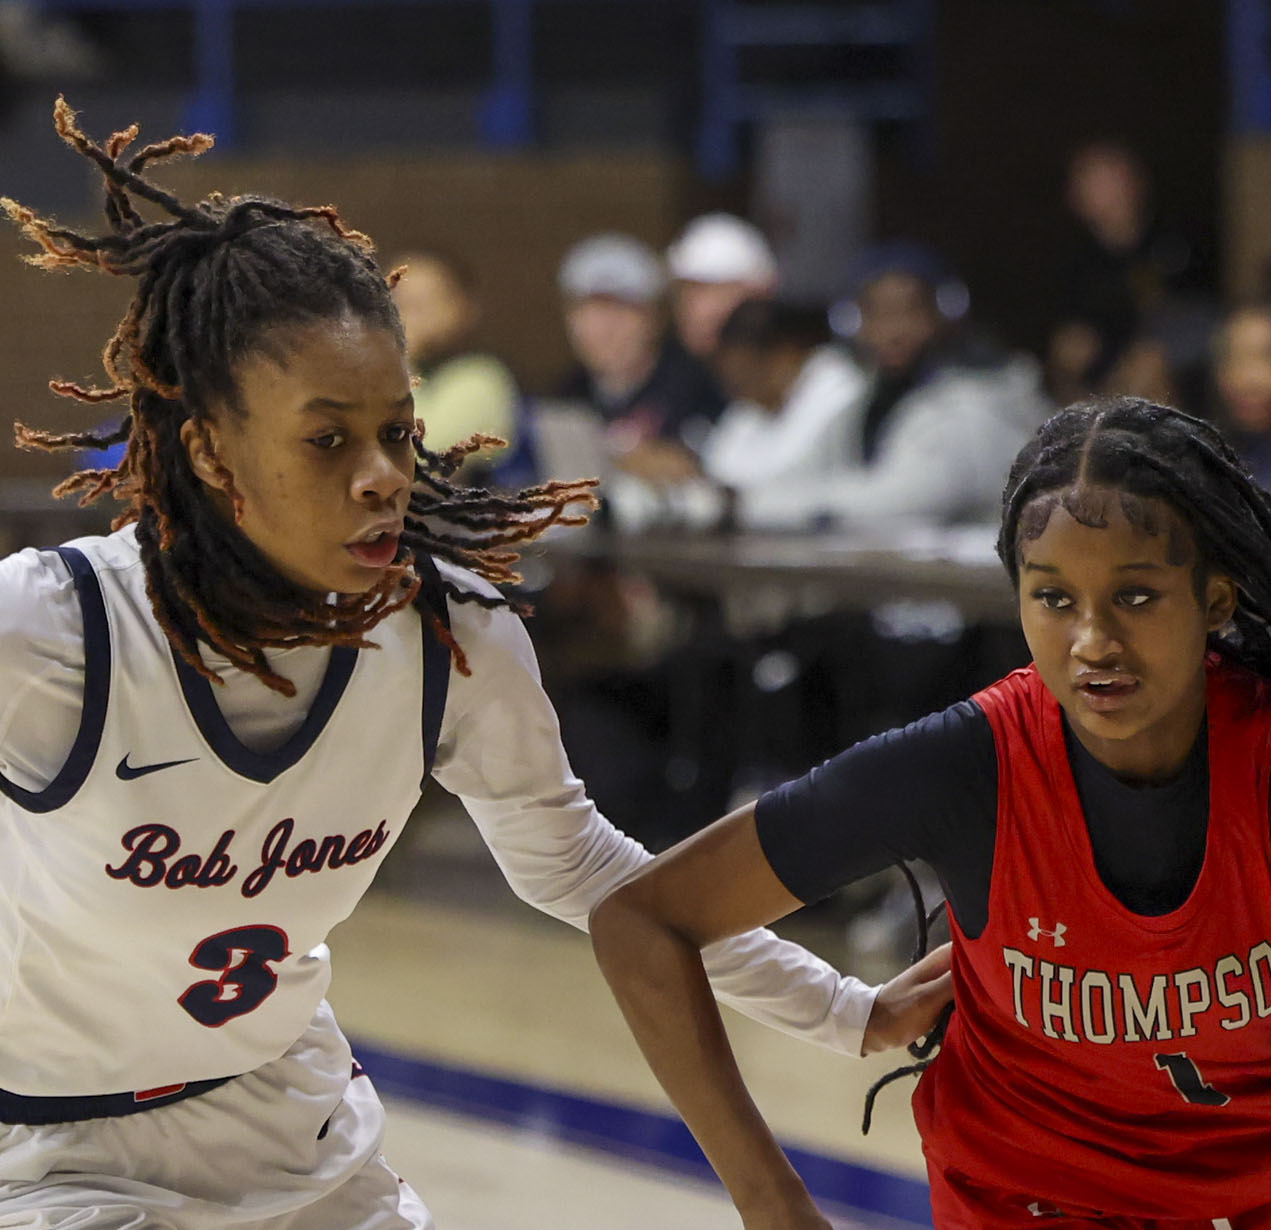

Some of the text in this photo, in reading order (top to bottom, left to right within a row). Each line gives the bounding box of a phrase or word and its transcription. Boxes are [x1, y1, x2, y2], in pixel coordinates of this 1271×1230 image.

[105, 817, 390, 898] Bob Jones
[177, 924, 292, 1028] 3
[1155, 1051, 1232, 1107] 1
